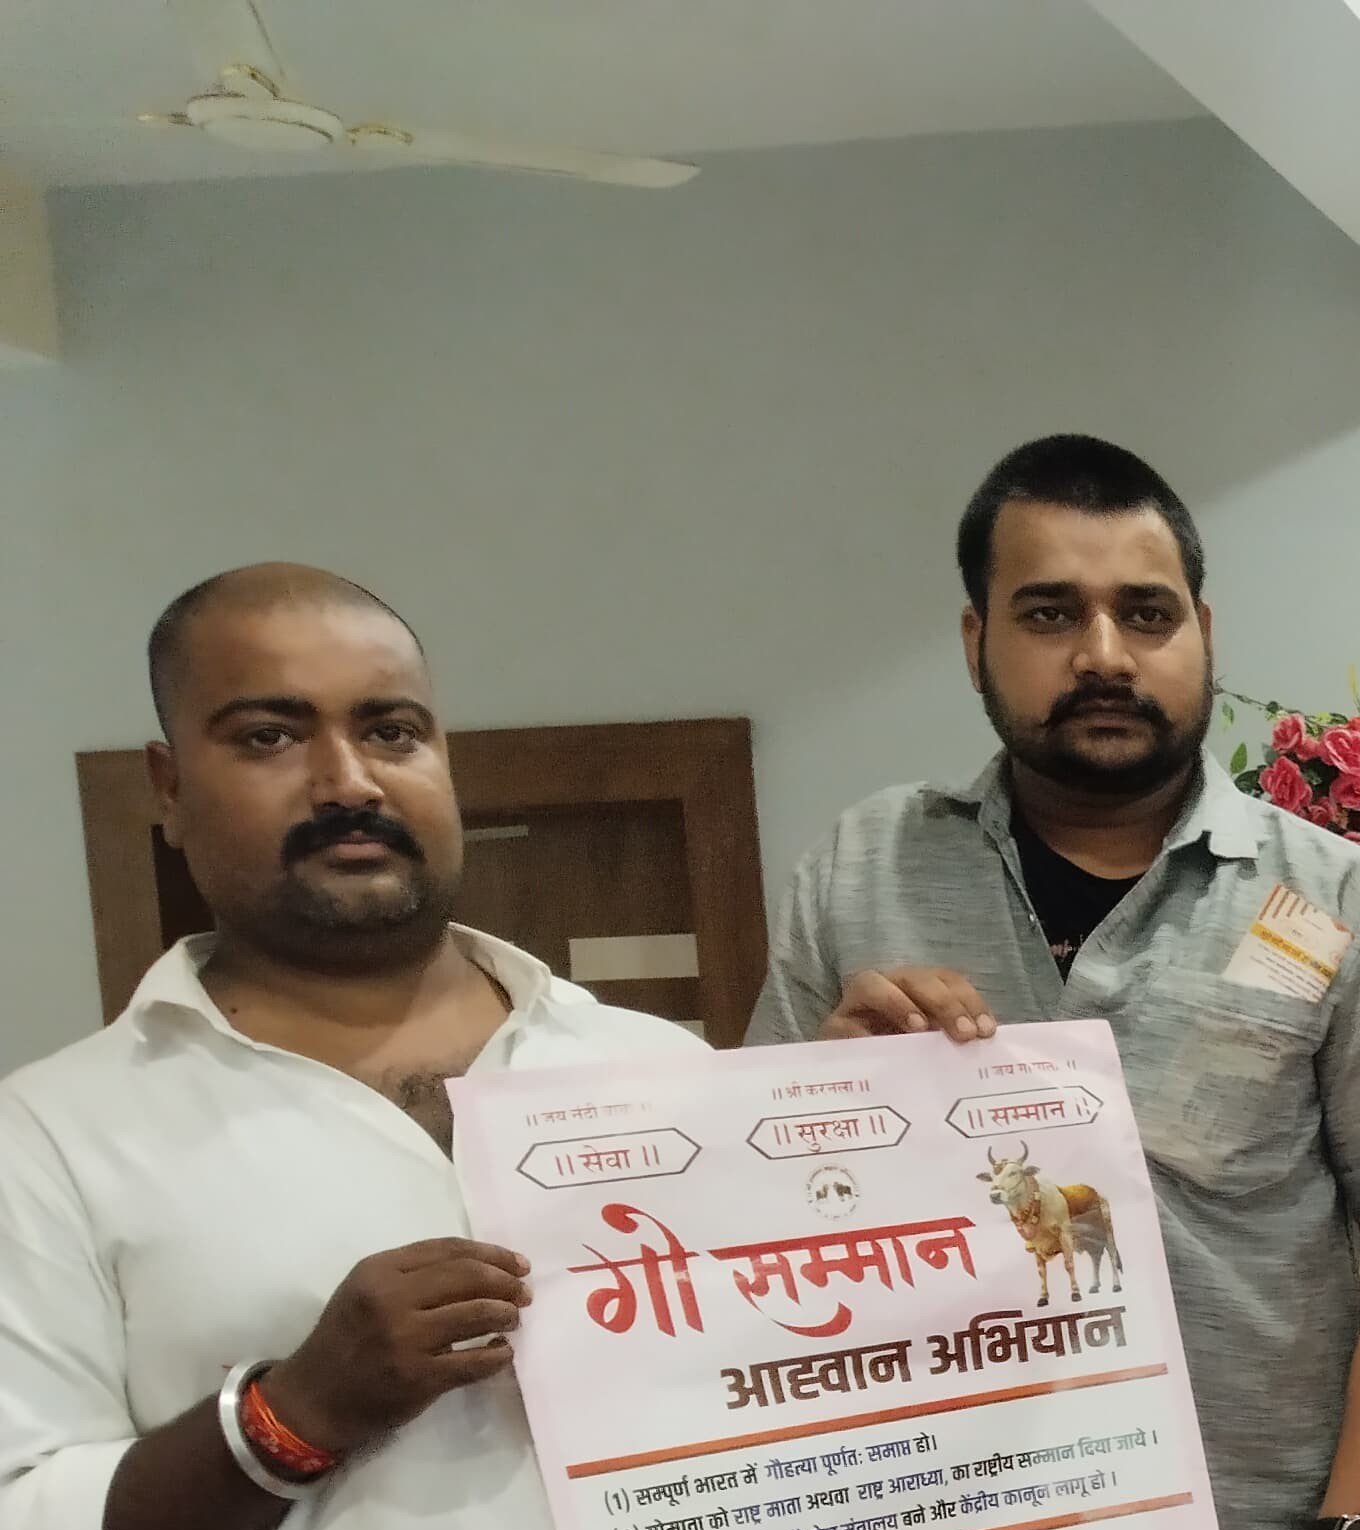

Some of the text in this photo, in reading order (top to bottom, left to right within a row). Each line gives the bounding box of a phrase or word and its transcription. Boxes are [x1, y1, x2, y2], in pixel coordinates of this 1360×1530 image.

[796, 1110, 859, 1150] सुरक्षा
[989, 1100, 1065, 1125] सम्मान
[578, 1144, 631, 1173] सेवा
[707, 1216, 978, 1338] सम्मान
[929, 1305, 1129, 1380] अभियान
[604, 1488, 630, 1516] (1)
[632, 1474, 691, 1507] सम्पूर्ण
[693, 1471, 739, 1494] भारत
[739, 1462, 758, 1484] में
[763, 1456, 818, 1480] गौहत्या
[864, 1439, 911, 1462] समाप्त
[704, 1506, 730, 1530] को
[730, 1504, 761, 1525] राष्ट्र
[762, 1496, 802, 1518] माता
[805, 1486, 850, 1510] अथवा
[855, 1480, 883, 1500] राष्ट्र
[949, 1463, 971, 1481] का
[971, 1452, 1014, 1478] राष्ट्रीय
[1015, 1444, 1074, 1469] सम्मान
[1077, 1438, 1110, 1457] दिया
[1111, 1425, 1150, 1453] जाये
[899, 1503, 926, 1527] बने
[928, 1498, 957, 1521] और
[957, 1490, 1000, 1514] केंद्रीय
[1001, 1484, 1050, 1507] कानून
[1055, 1477, 1089, 1497] लागू
[1088, 1469, 1105, 1490] हो
